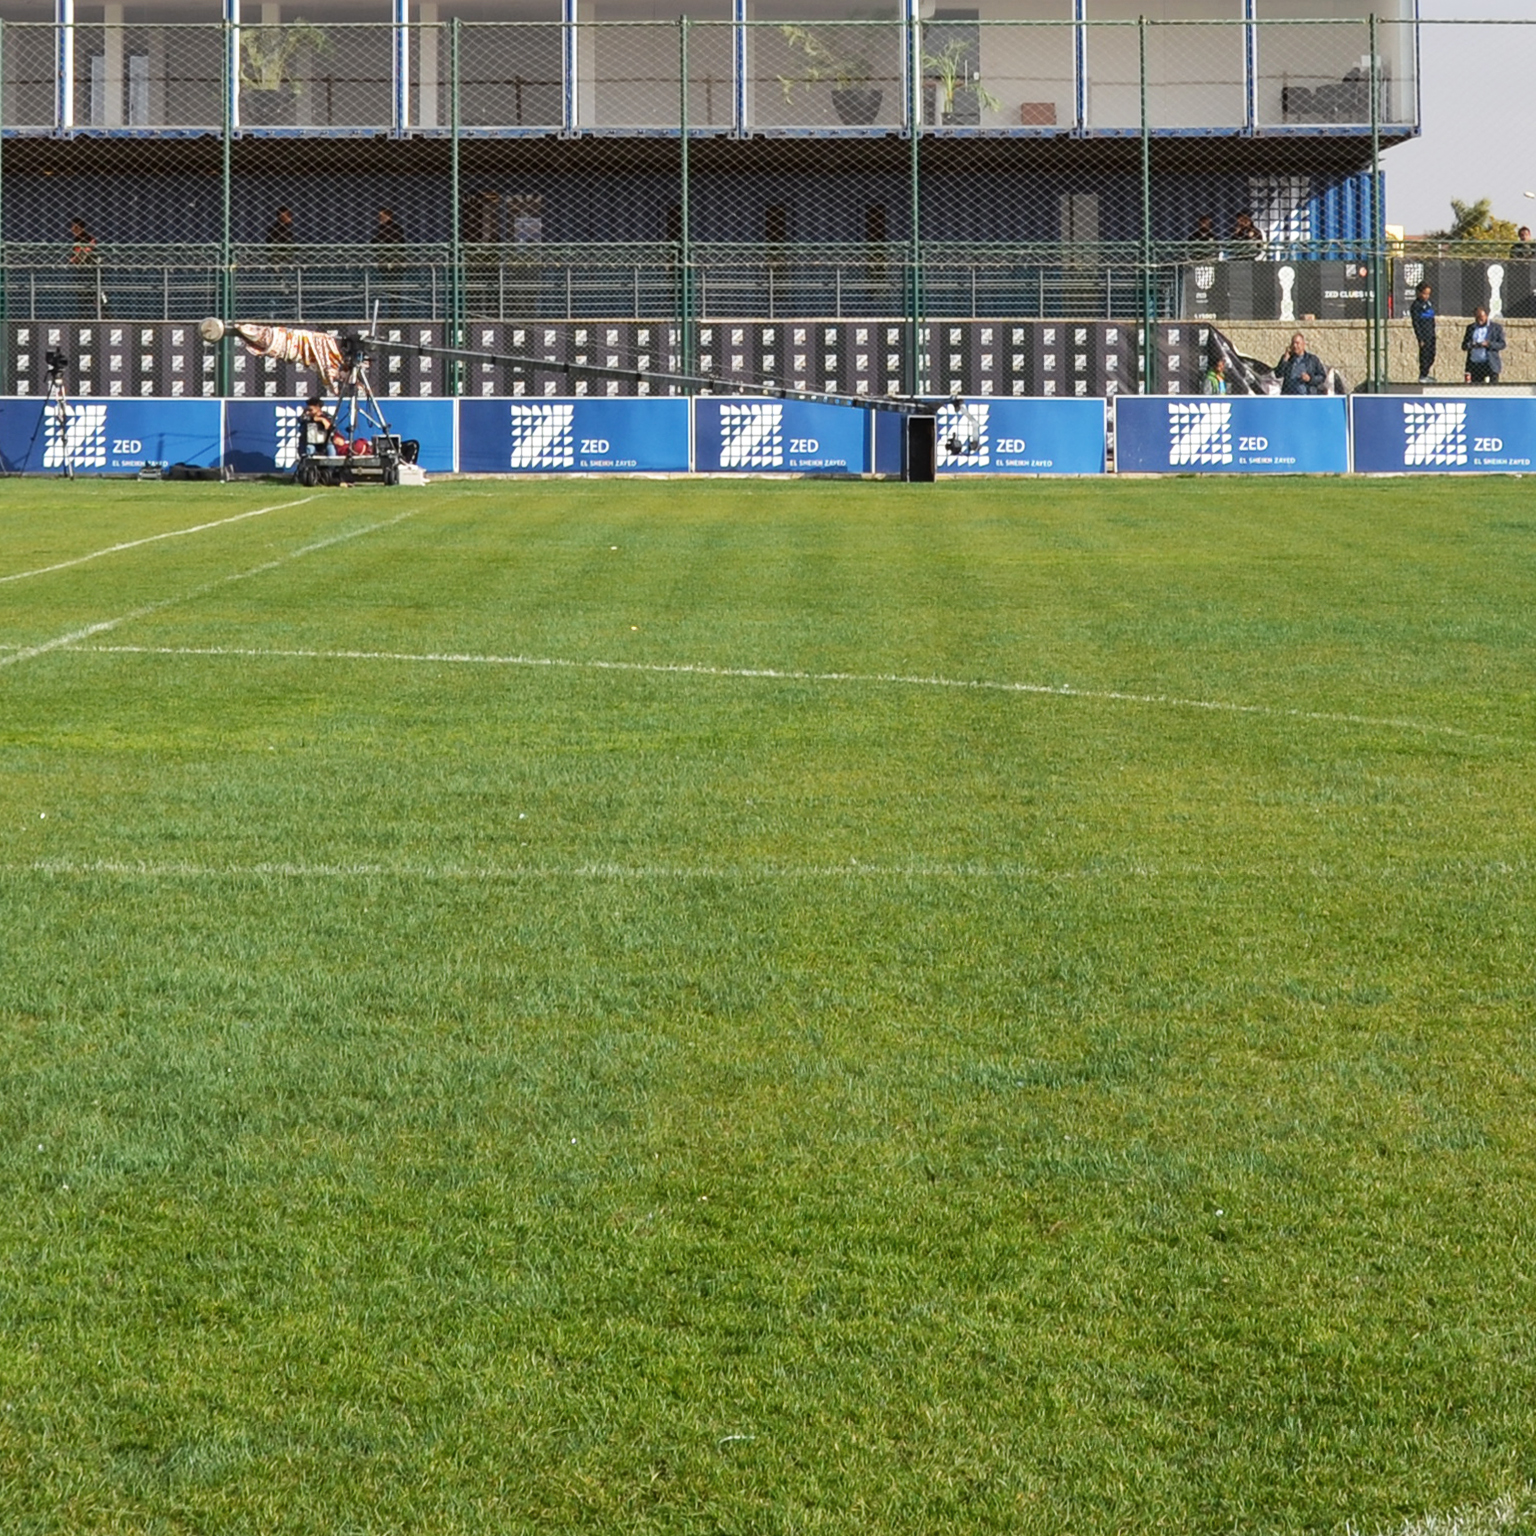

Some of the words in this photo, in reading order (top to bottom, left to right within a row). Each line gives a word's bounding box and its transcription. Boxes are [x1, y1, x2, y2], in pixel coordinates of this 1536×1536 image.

[112, 439, 142, 454] ZED
[580, 439, 610, 454] ZED
[789, 439, 819, 453] ZED
[996, 439, 1026, 453] ZED
[1238, 437, 1268, 451] ZED
[1473, 437, 1503, 452] ZED
